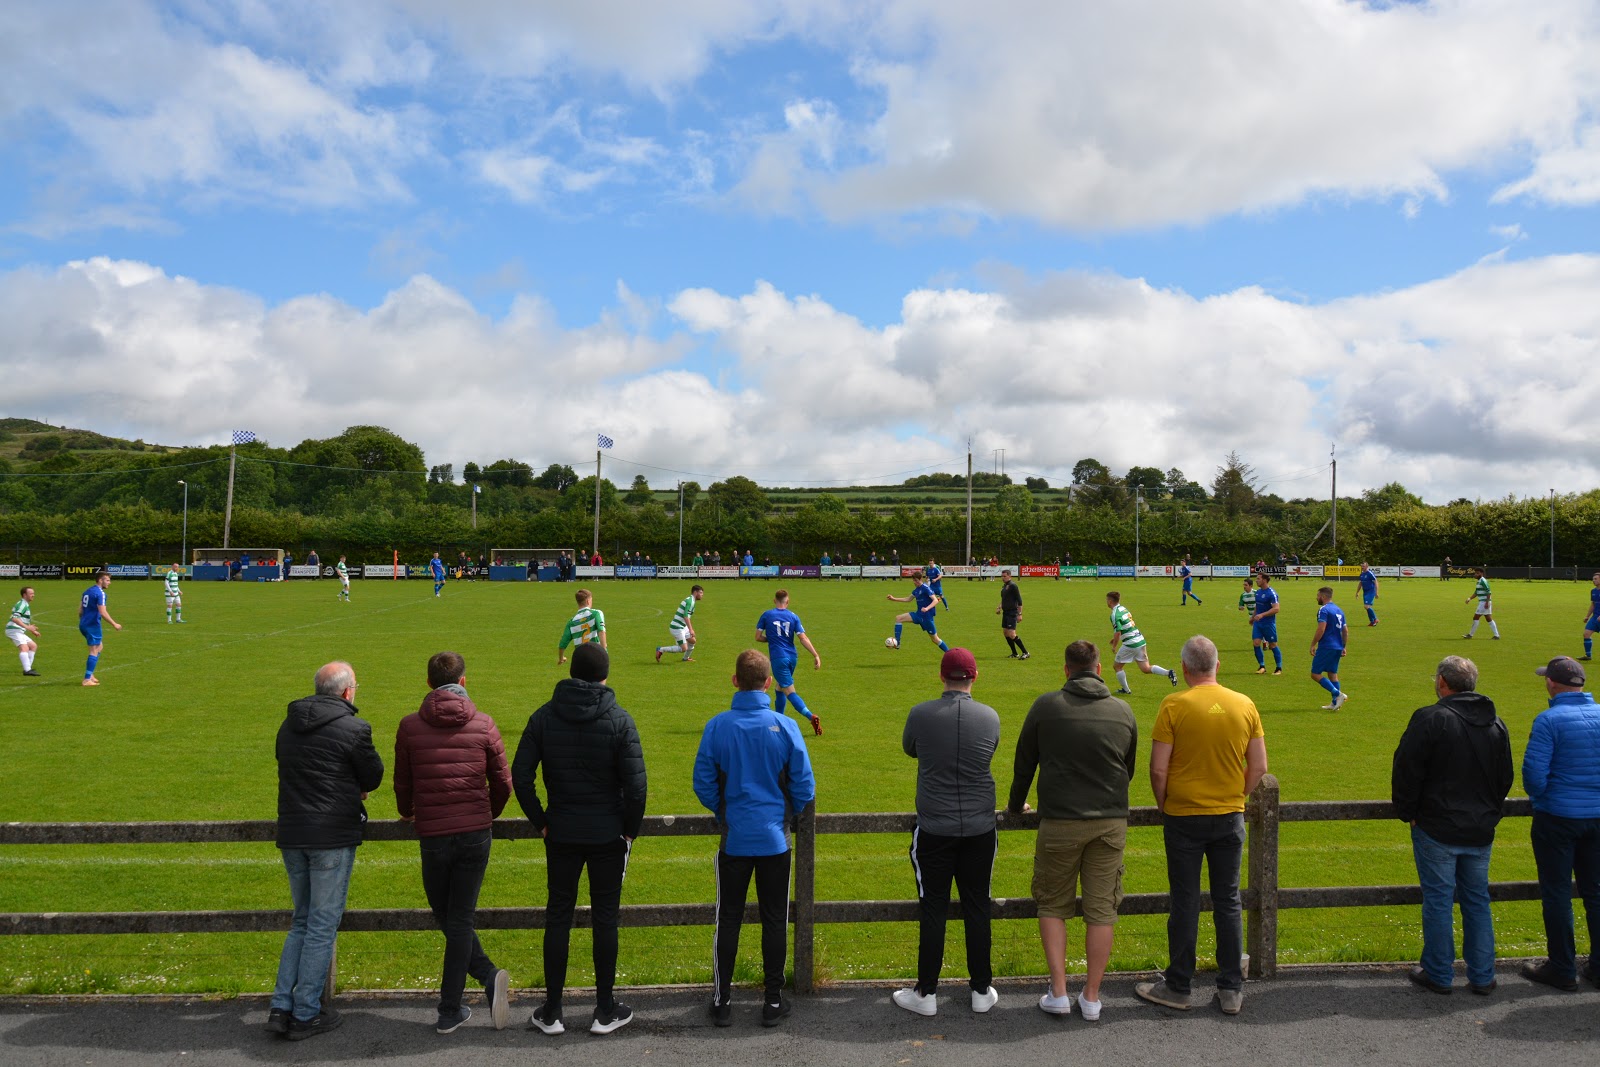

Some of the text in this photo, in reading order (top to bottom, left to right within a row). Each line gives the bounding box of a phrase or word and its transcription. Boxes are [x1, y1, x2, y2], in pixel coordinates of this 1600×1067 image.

[782, 568, 805, 576] Albany
[82, 594, 89, 608] 9
[772, 620, 791, 638] 11
[1335, 613, 1343, 629] 3
[580, 623, 591, 644] 2
